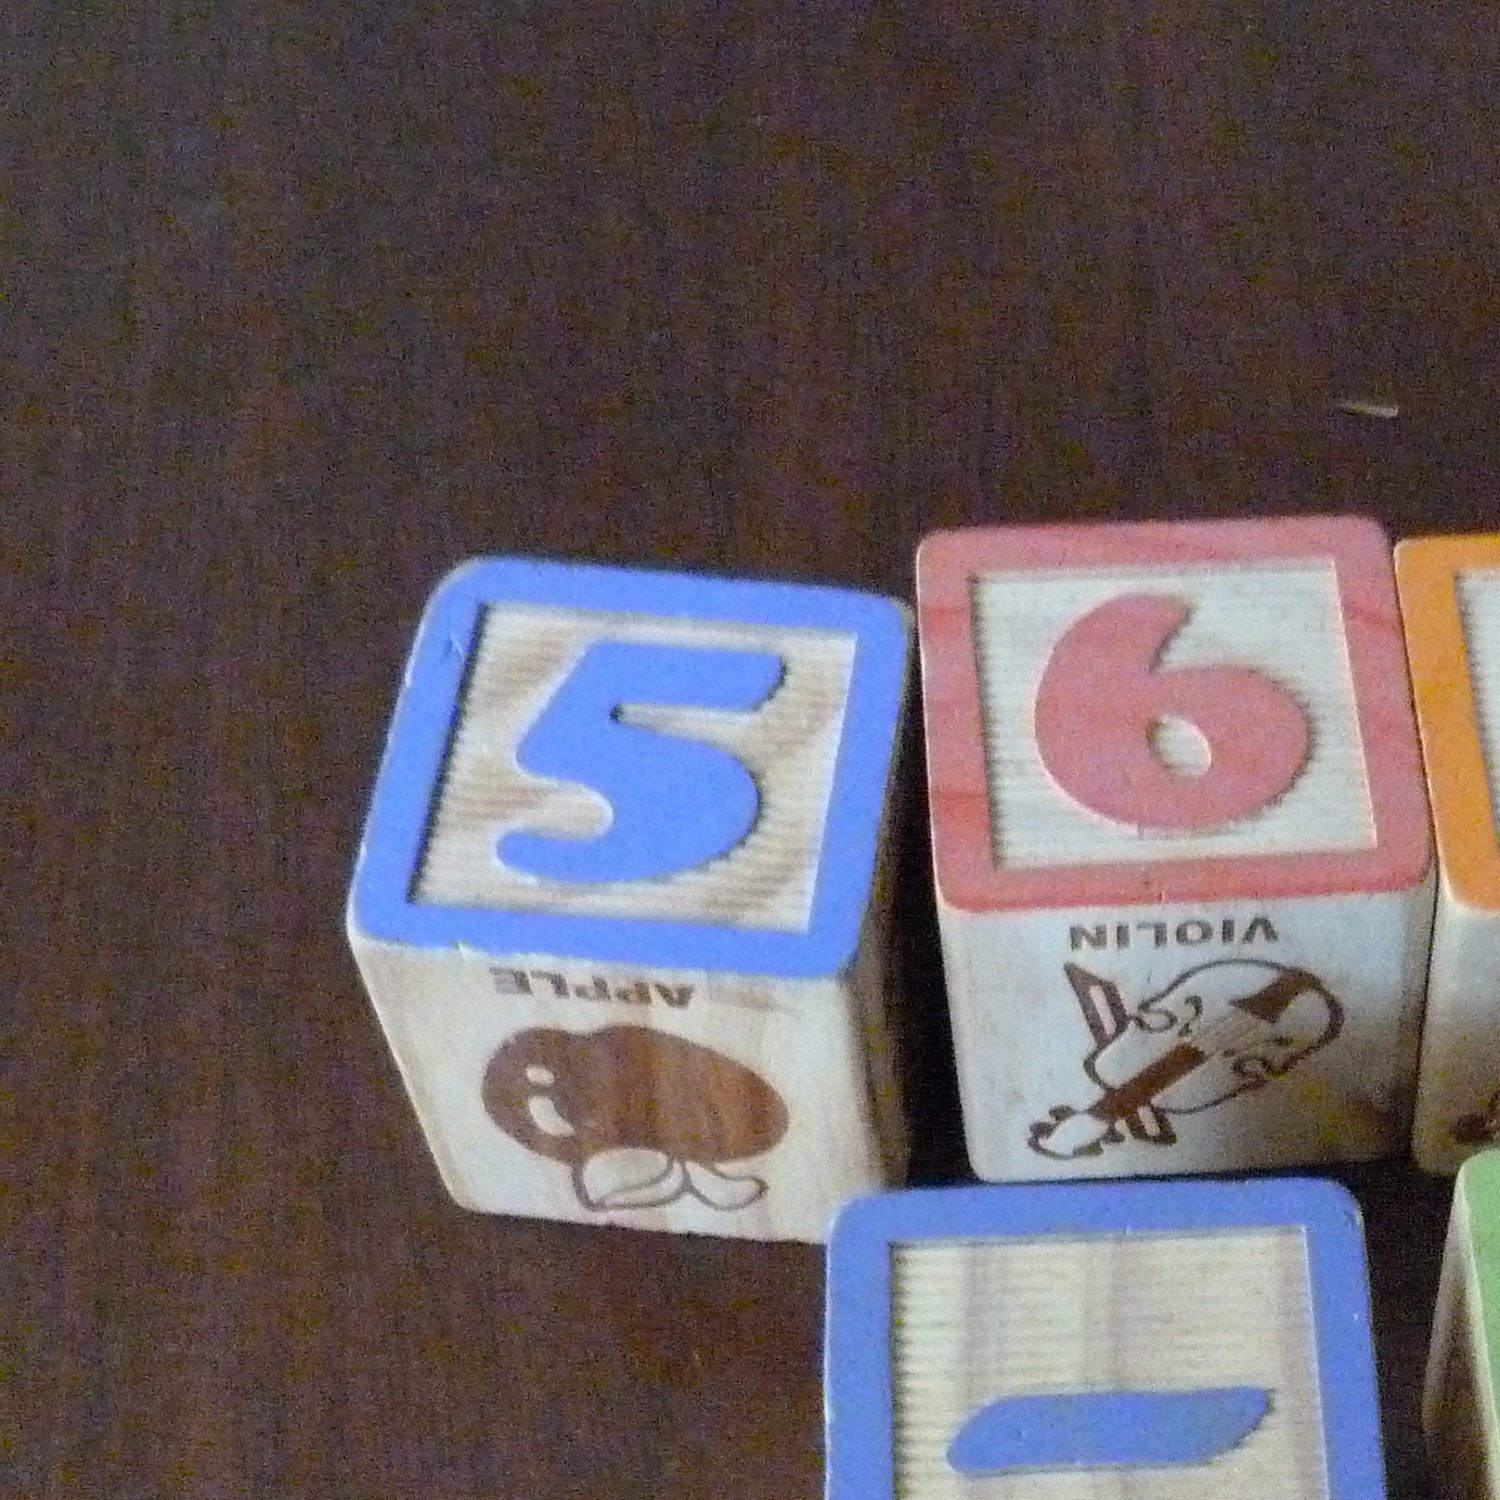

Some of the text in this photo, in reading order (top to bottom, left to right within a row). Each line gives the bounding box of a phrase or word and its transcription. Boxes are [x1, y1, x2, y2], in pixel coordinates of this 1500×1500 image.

[497, 639, 786, 884] 5
[1033, 592, 1310, 831] 6
[492, 966, 695, 1008] APPLE
[1067, 914, 1281, 951] VIOLIN
